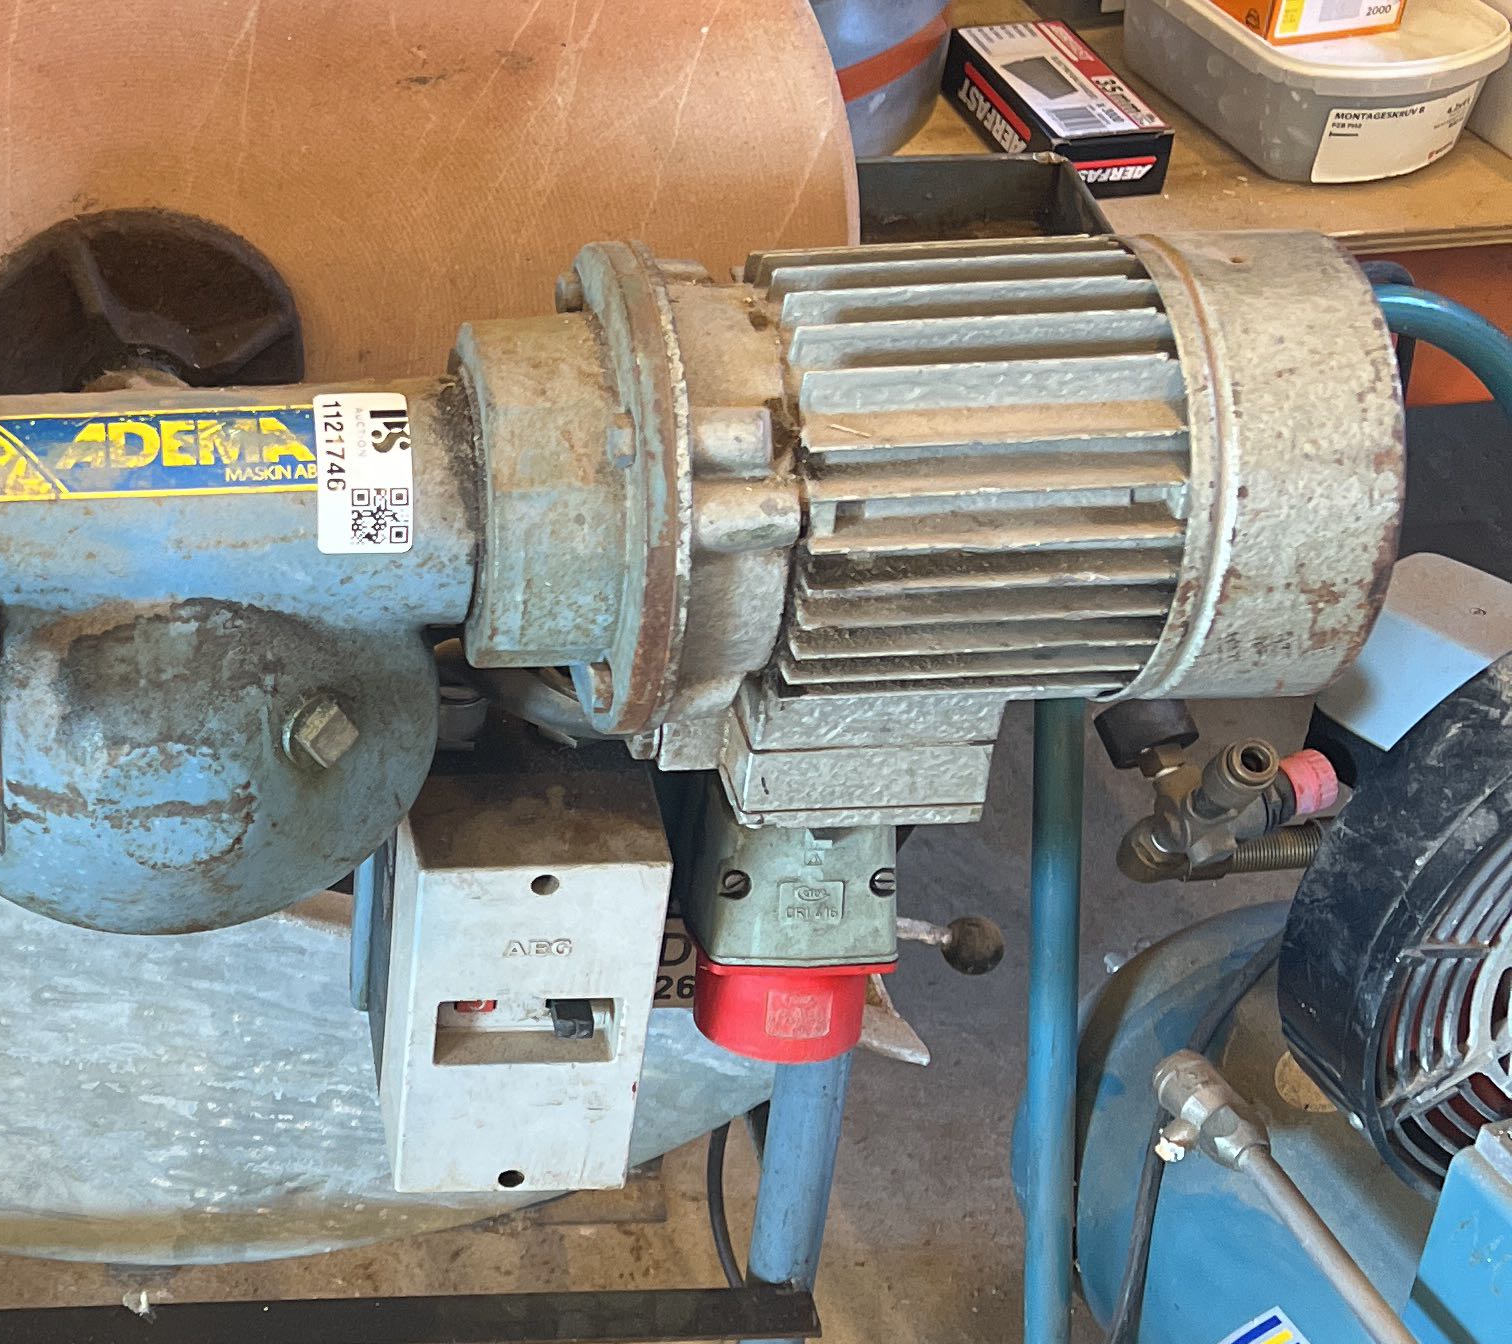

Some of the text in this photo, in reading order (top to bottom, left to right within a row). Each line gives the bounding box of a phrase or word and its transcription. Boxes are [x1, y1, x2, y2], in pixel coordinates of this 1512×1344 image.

[1366, 4, 1392, 17] 2000
[957, 77, 1028, 154] AERFAST
[1334, 108, 1418, 121] MONTAGESKRUV
[55, 417, 317, 469] ADEMA
[354, 408, 367, 457] AUCTION
[322, 401, 346, 492] 1121746
[225, 464, 292, 483] MASKIN
[502, 937, 573, 958] AEG
[654, 974, 696, 1001] 26
